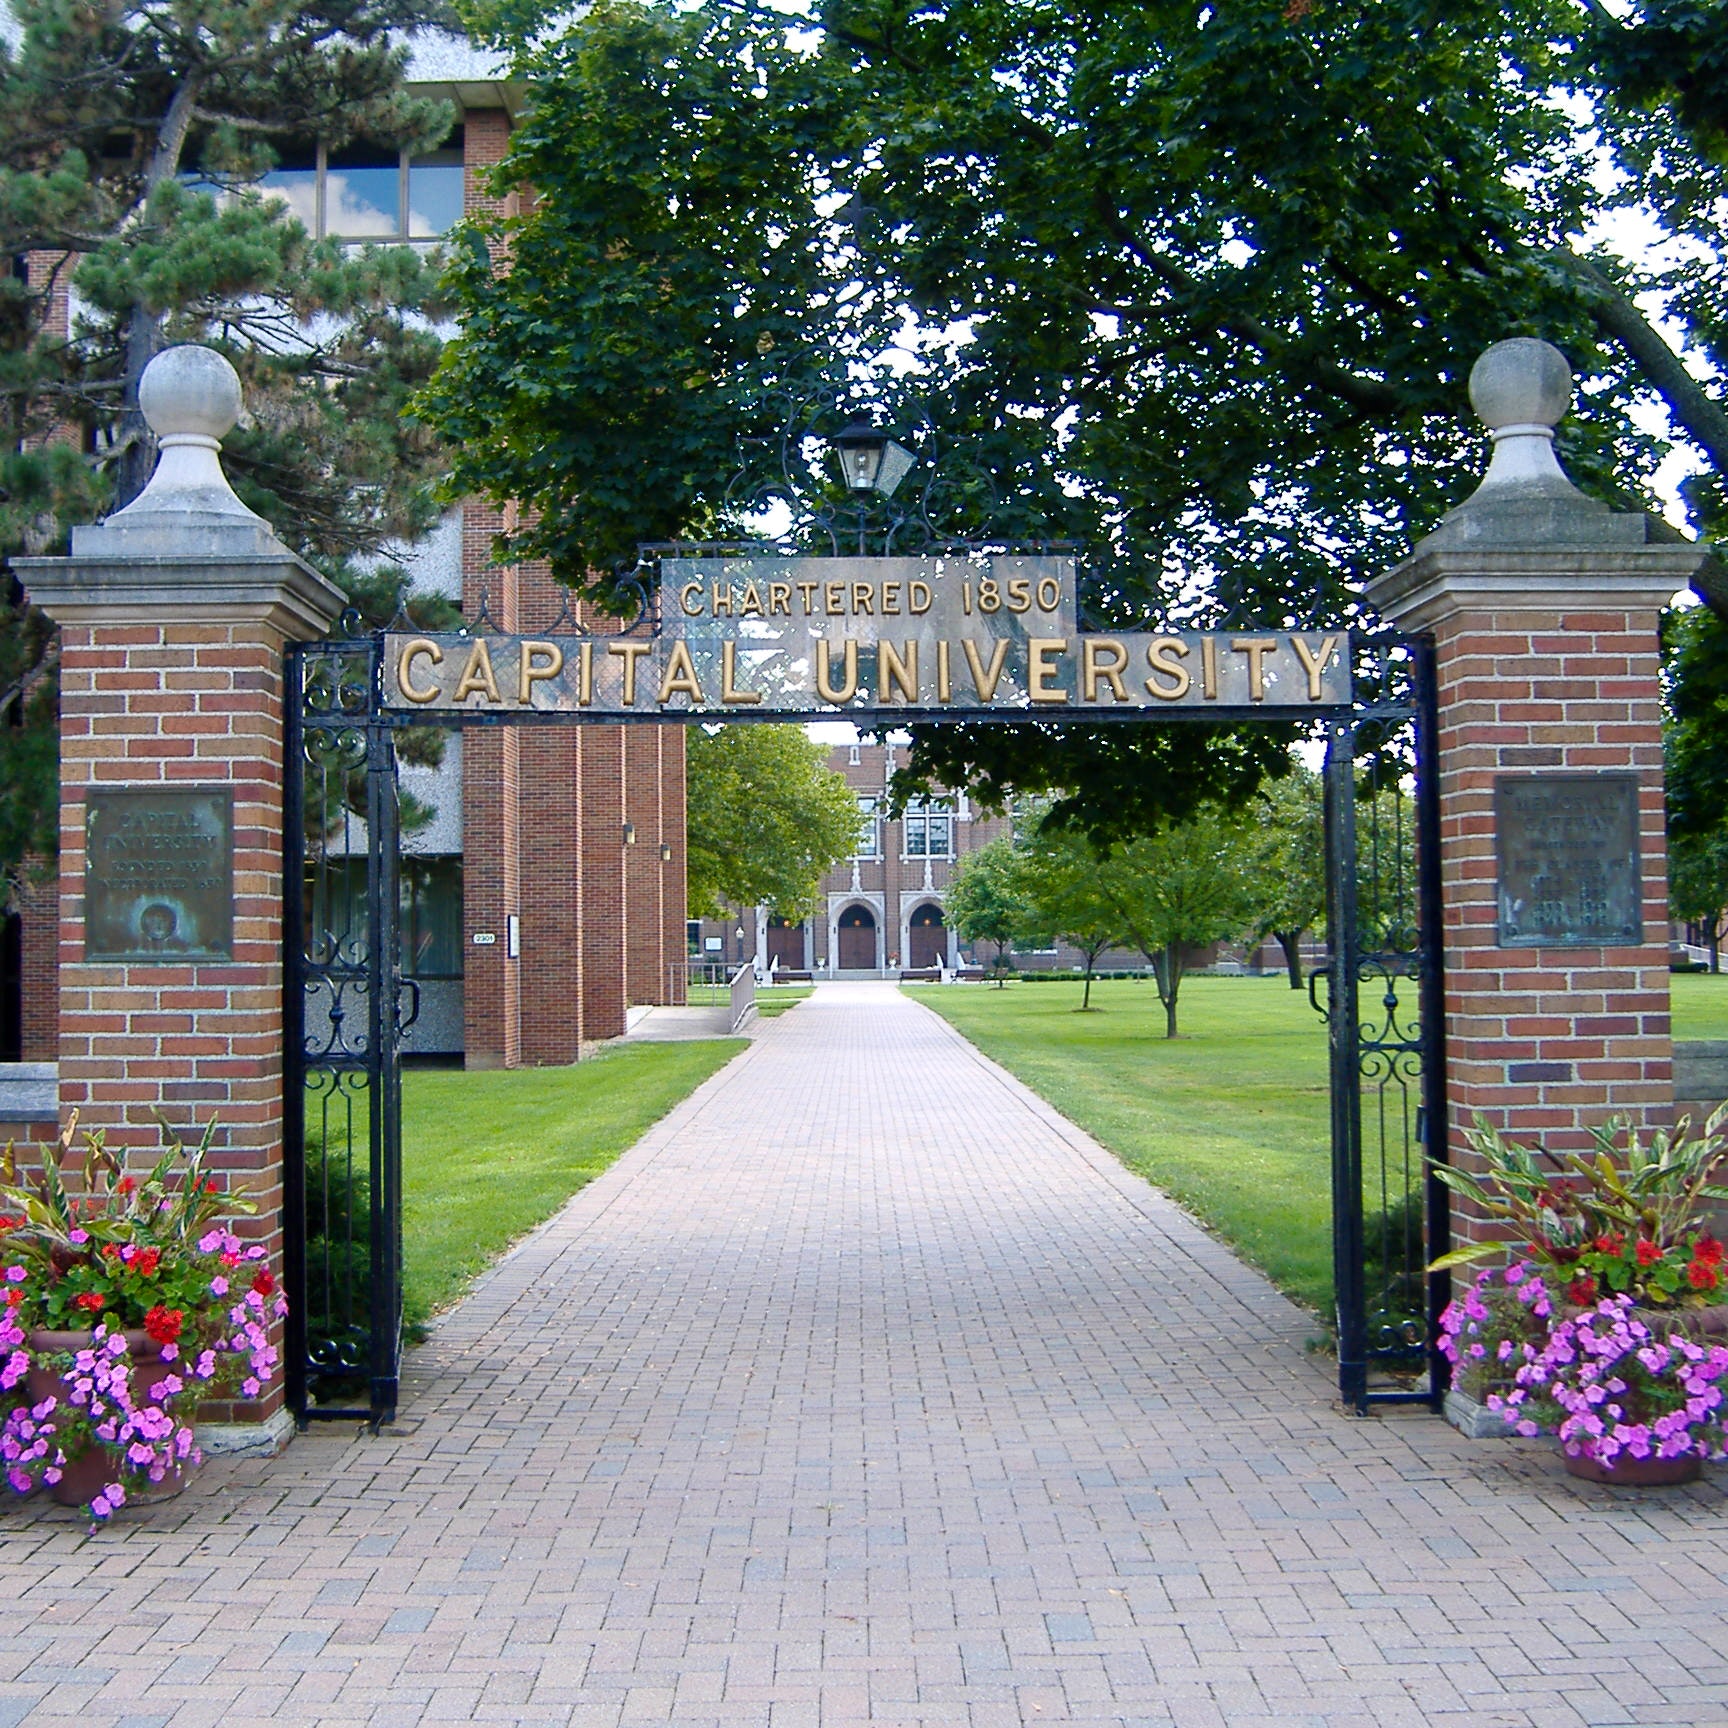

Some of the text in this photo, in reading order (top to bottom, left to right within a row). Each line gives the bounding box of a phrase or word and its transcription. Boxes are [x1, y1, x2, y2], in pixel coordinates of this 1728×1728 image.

[680, 577, 1062, 616] CHARTERED 1850
[397, 636, 1339, 706] CAPITAL UNIVERSITY
